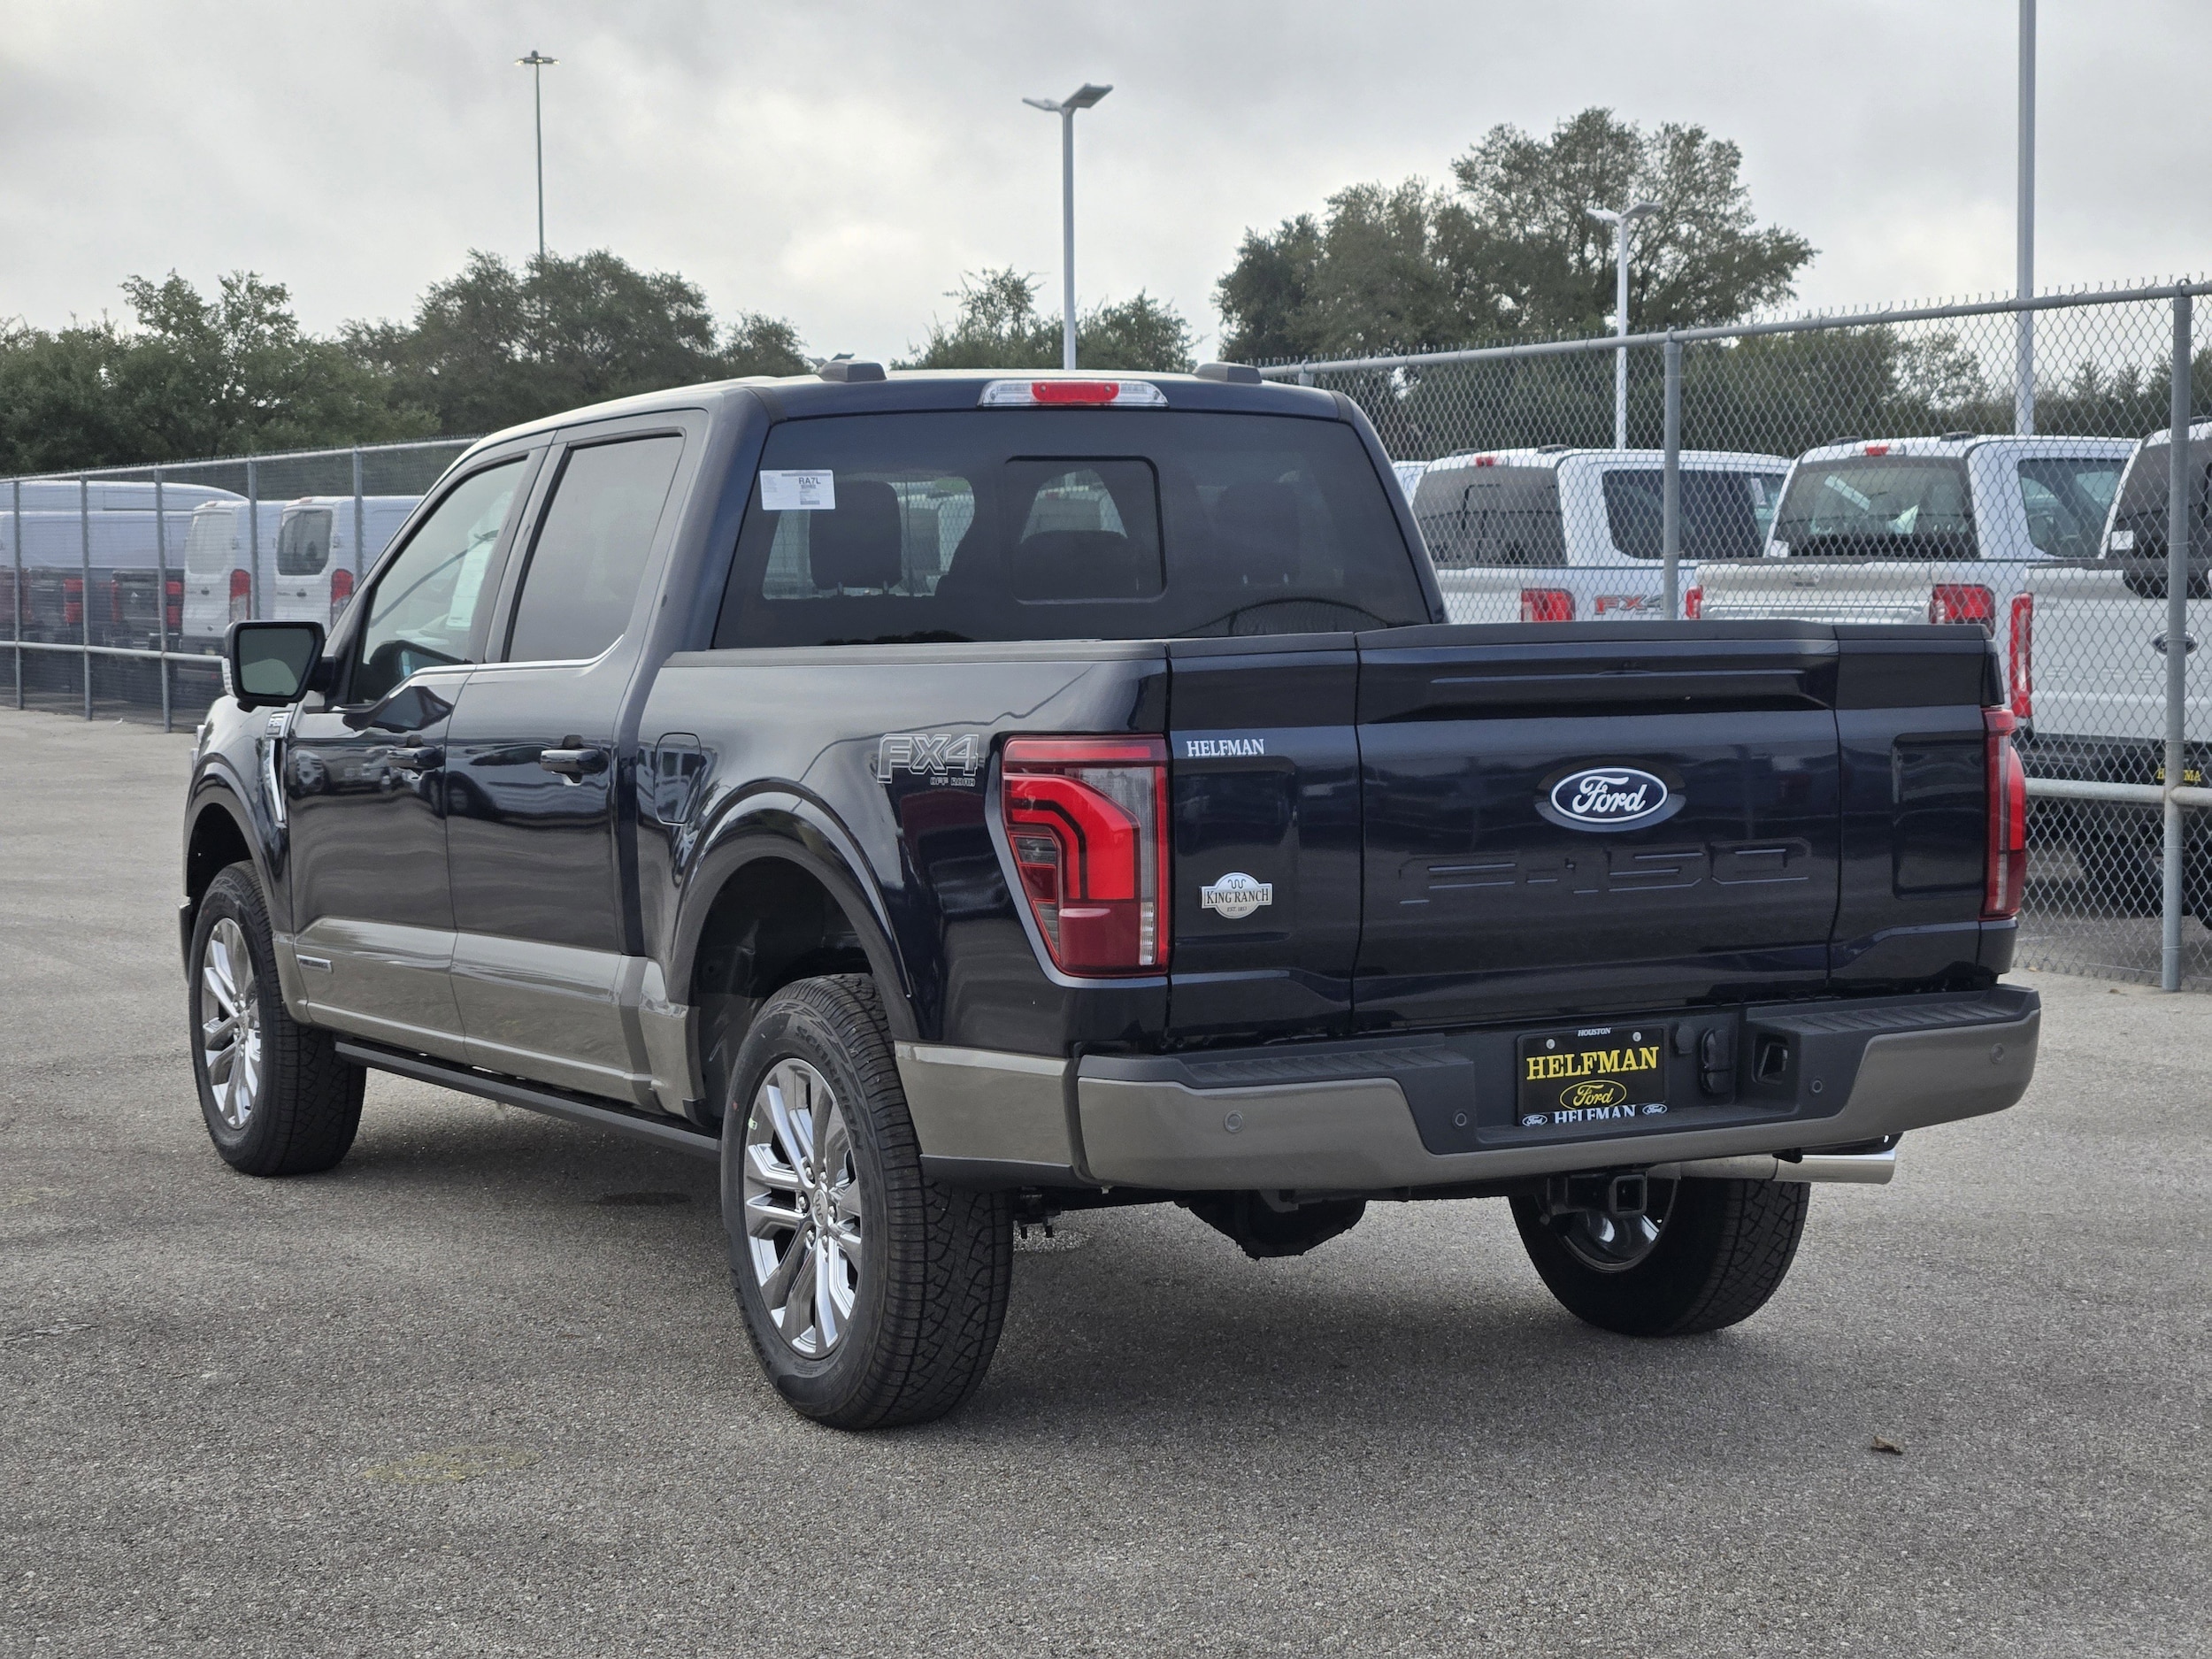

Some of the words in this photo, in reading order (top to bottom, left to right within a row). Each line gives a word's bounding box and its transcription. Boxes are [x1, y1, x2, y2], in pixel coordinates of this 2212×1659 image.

[877, 733, 979, 784] FX4
[1187, 739, 1265, 757] HELFMAN
[1571, 775, 1648, 813] Ford
[1206, 890, 1232, 904] KING
[1234, 887, 1269, 902] RANCH
[1578, 1027, 1611, 1037] HOUSTON
[1526, 1047, 1659, 1080] HELFMAN
[1572, 1084, 1615, 1107] Ford
